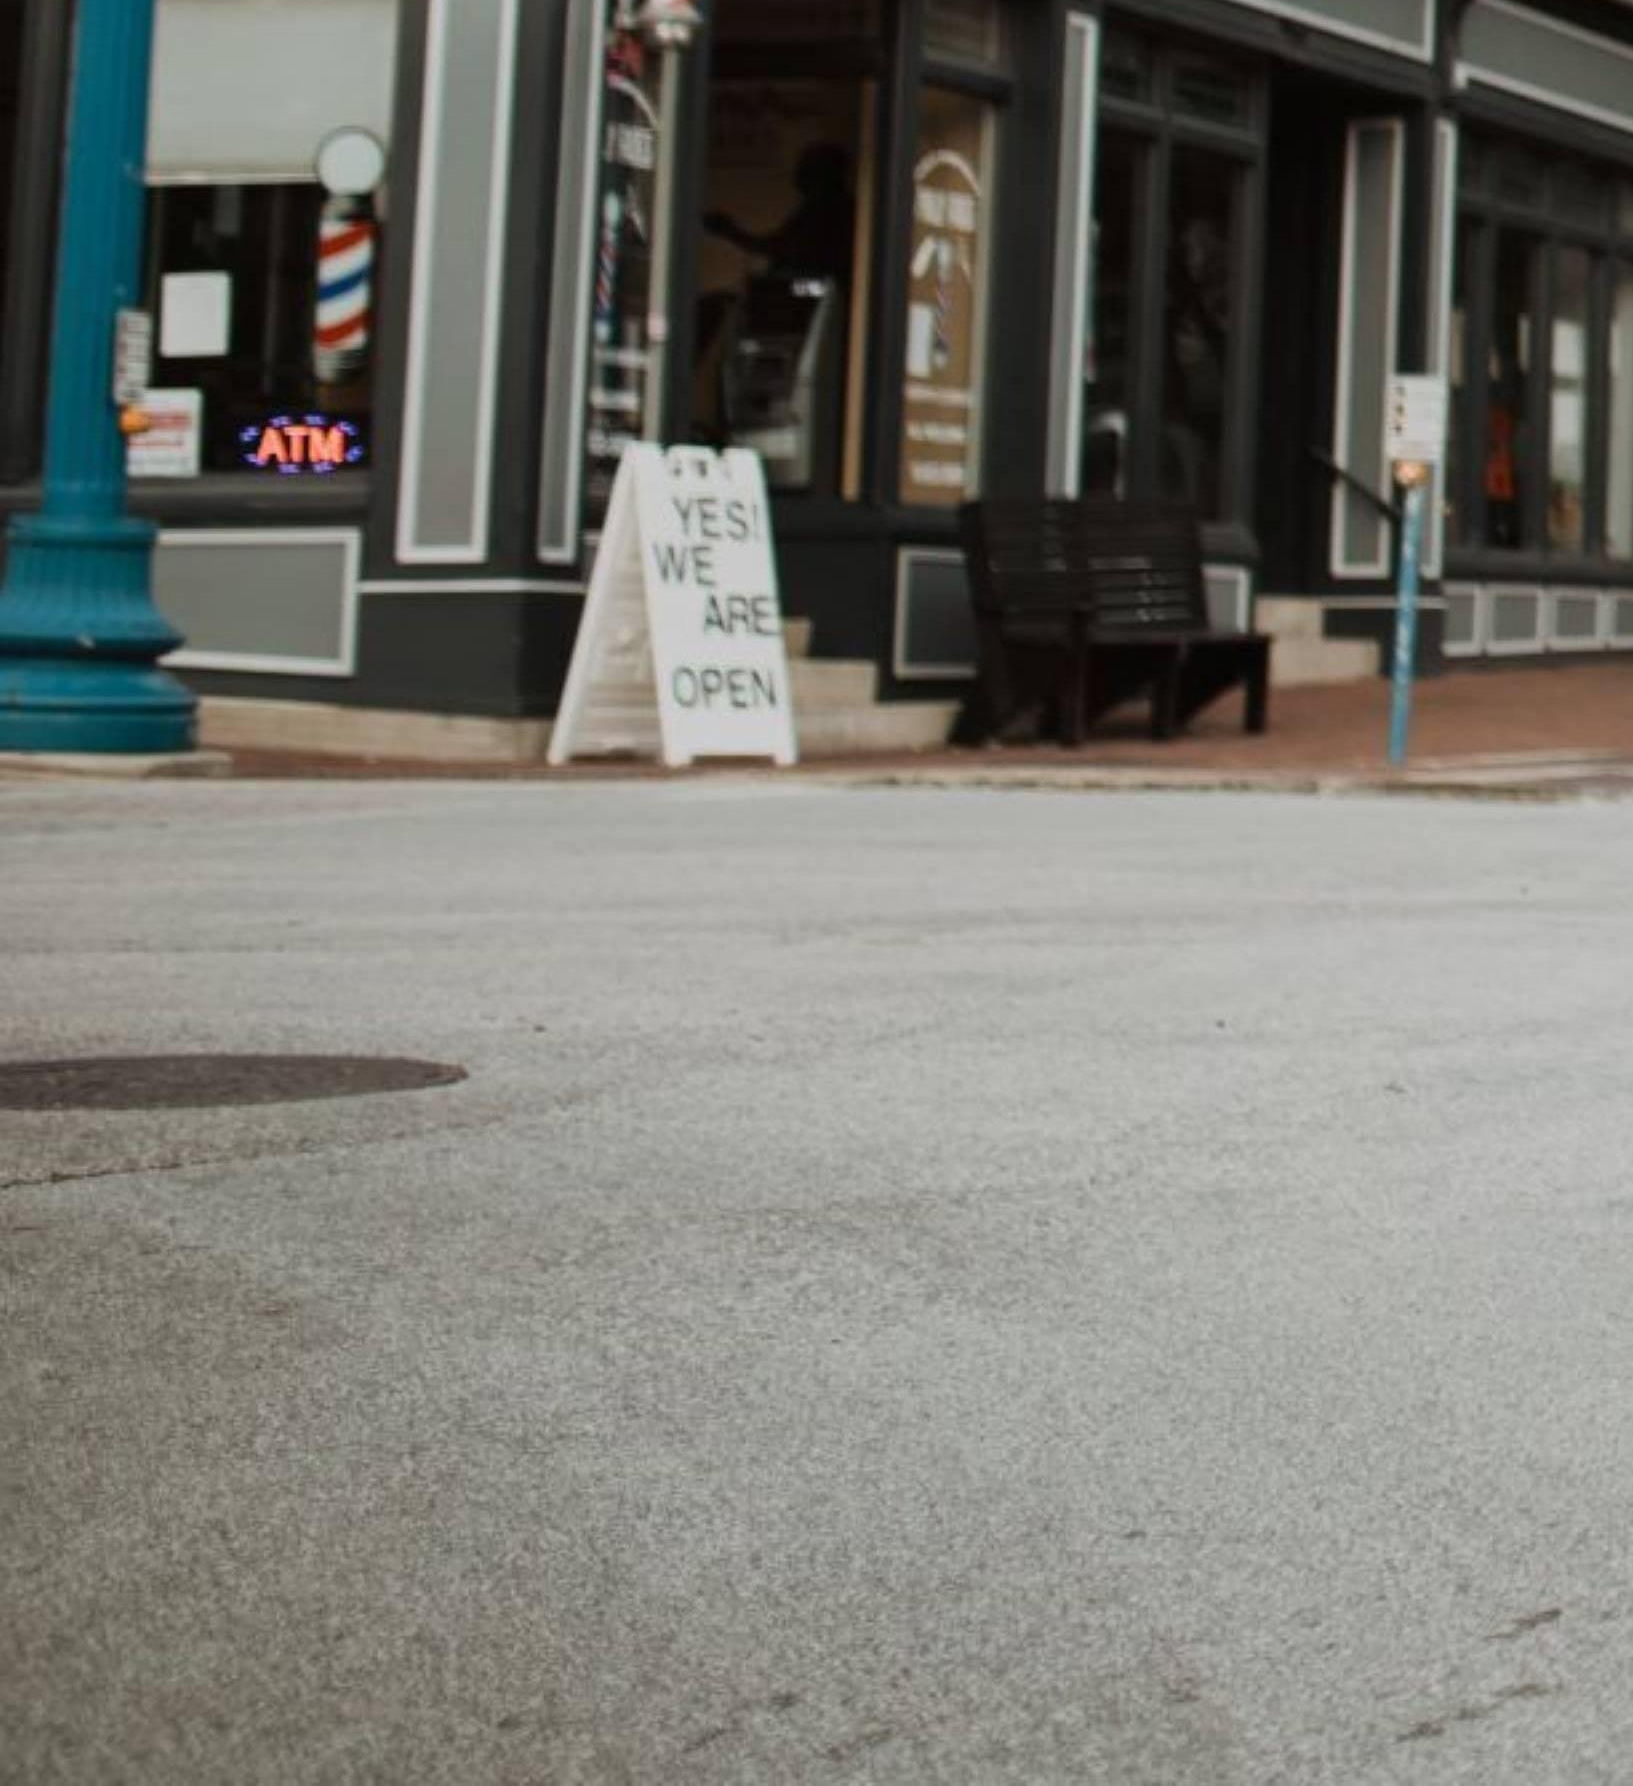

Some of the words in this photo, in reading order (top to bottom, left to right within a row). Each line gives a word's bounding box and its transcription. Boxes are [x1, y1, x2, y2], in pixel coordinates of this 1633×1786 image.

[256, 425, 345, 465] ATM
[654, 543, 718, 587] WE
[703, 595, 780, 637] ARE
[672, 667, 778, 711] OPEN
